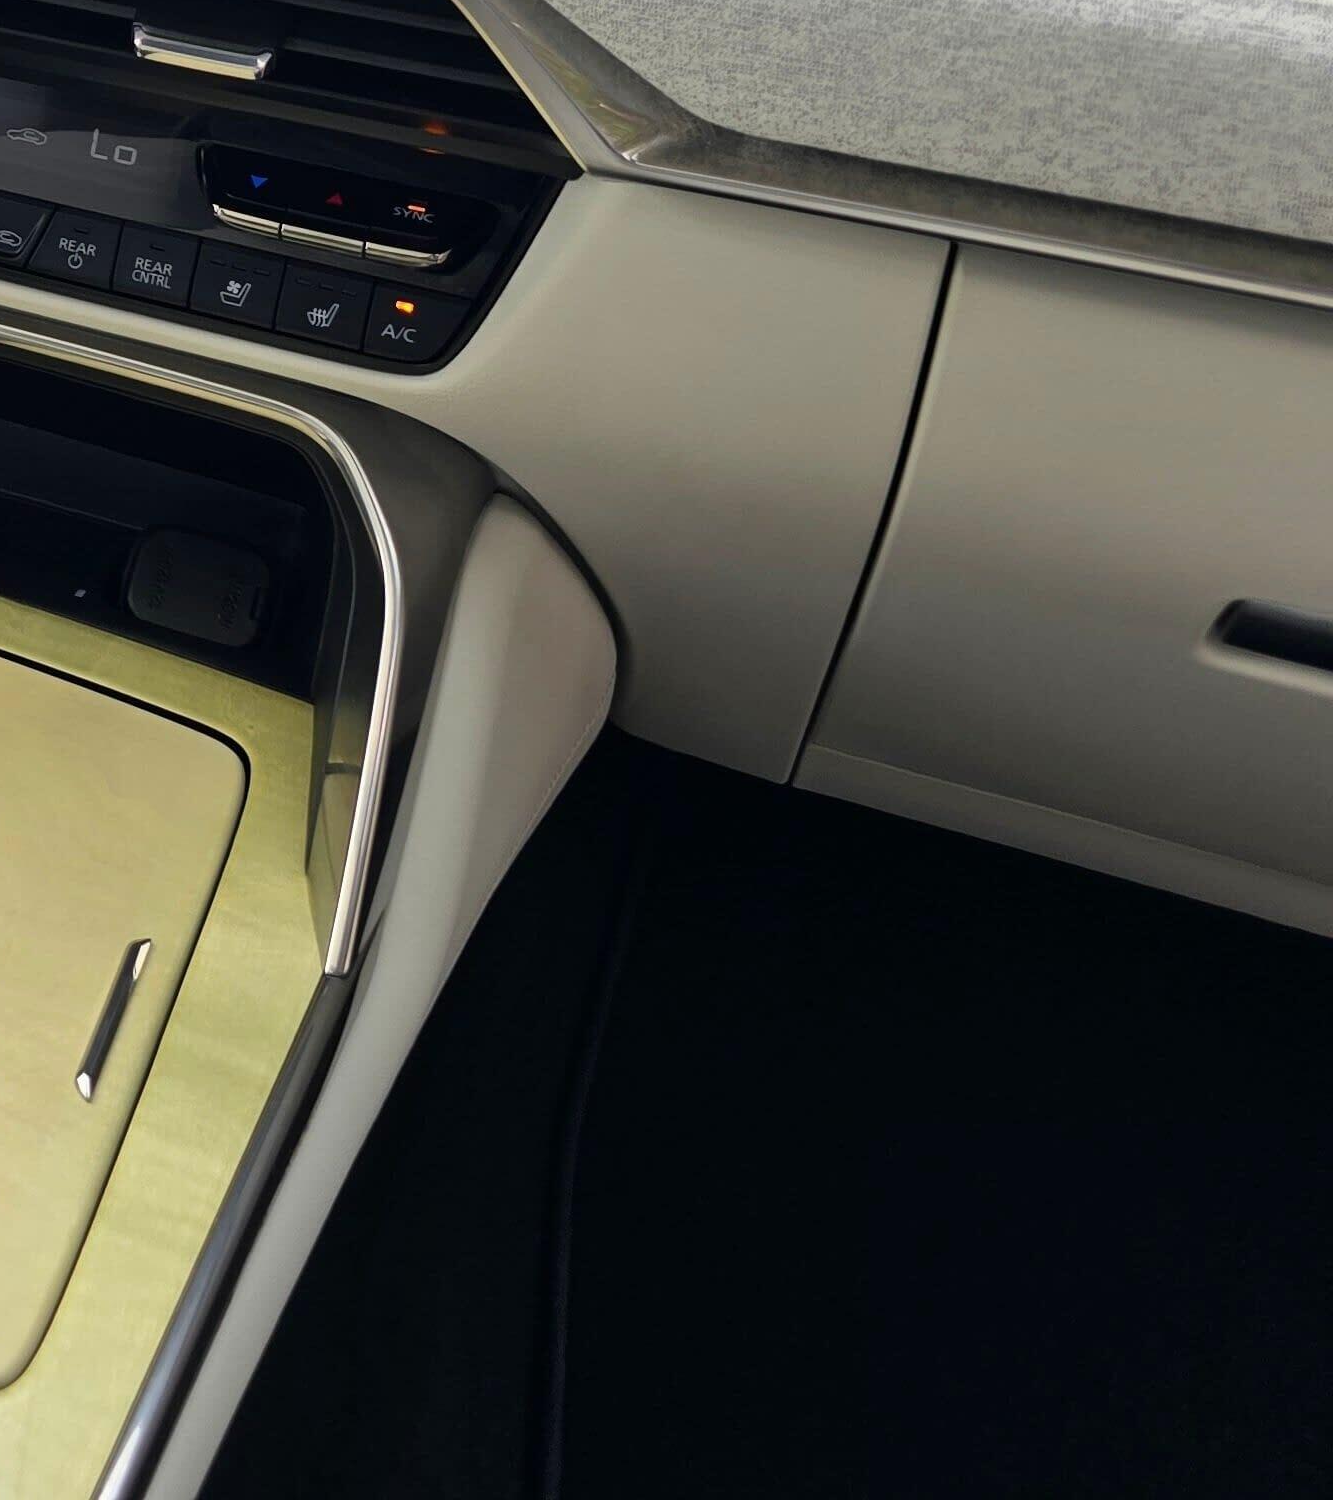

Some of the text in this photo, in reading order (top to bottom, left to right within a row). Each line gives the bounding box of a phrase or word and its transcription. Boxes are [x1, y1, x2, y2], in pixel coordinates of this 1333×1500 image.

[392, 205, 434, 224] SYNC
[59, 237, 97, 257] REAR
[134, 256, 174, 277] REAR
[131, 268, 172, 290] CNTRL
[381, 322, 417, 344] A/C
